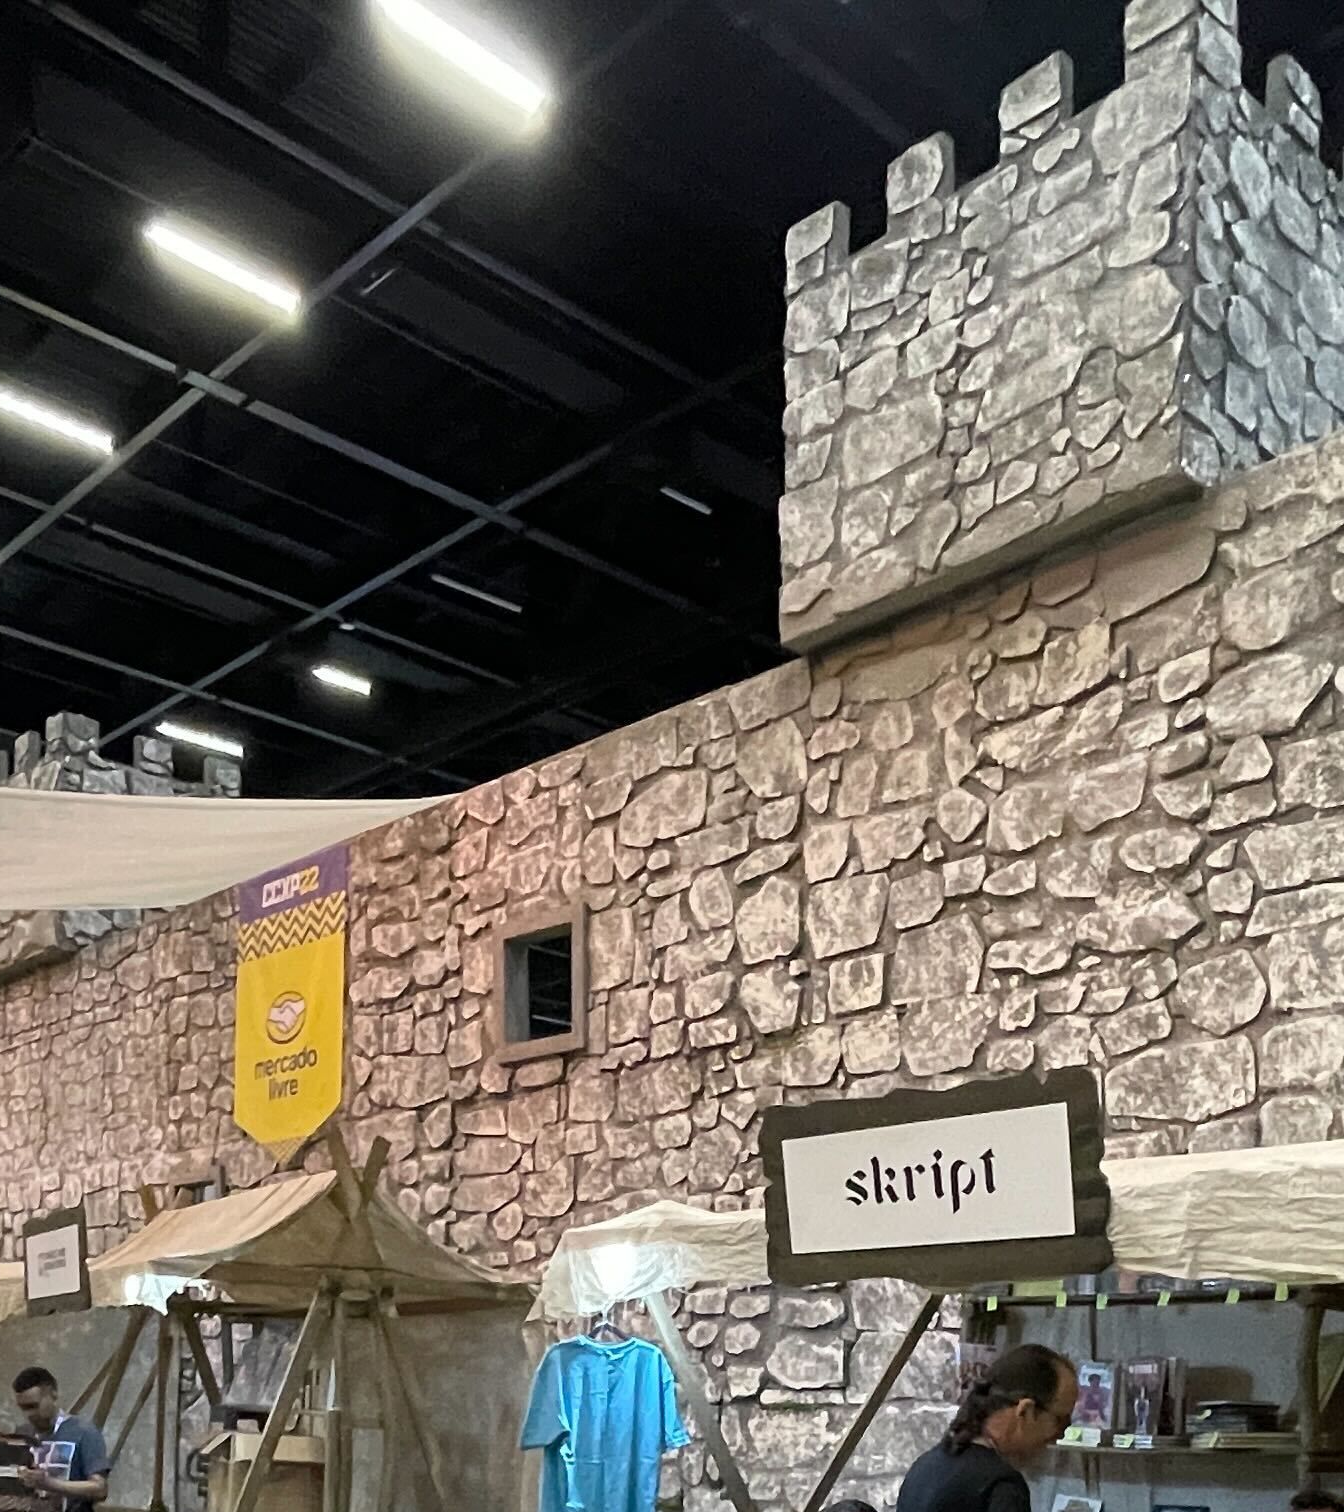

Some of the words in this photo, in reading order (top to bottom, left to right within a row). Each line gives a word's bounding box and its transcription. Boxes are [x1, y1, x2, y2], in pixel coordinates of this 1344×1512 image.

[261, 865, 320, 908] CCXP22
[254, 1046, 318, 1081] mercado
[268, 1078, 299, 1101] livre
[845, 1148, 996, 1215] skript
